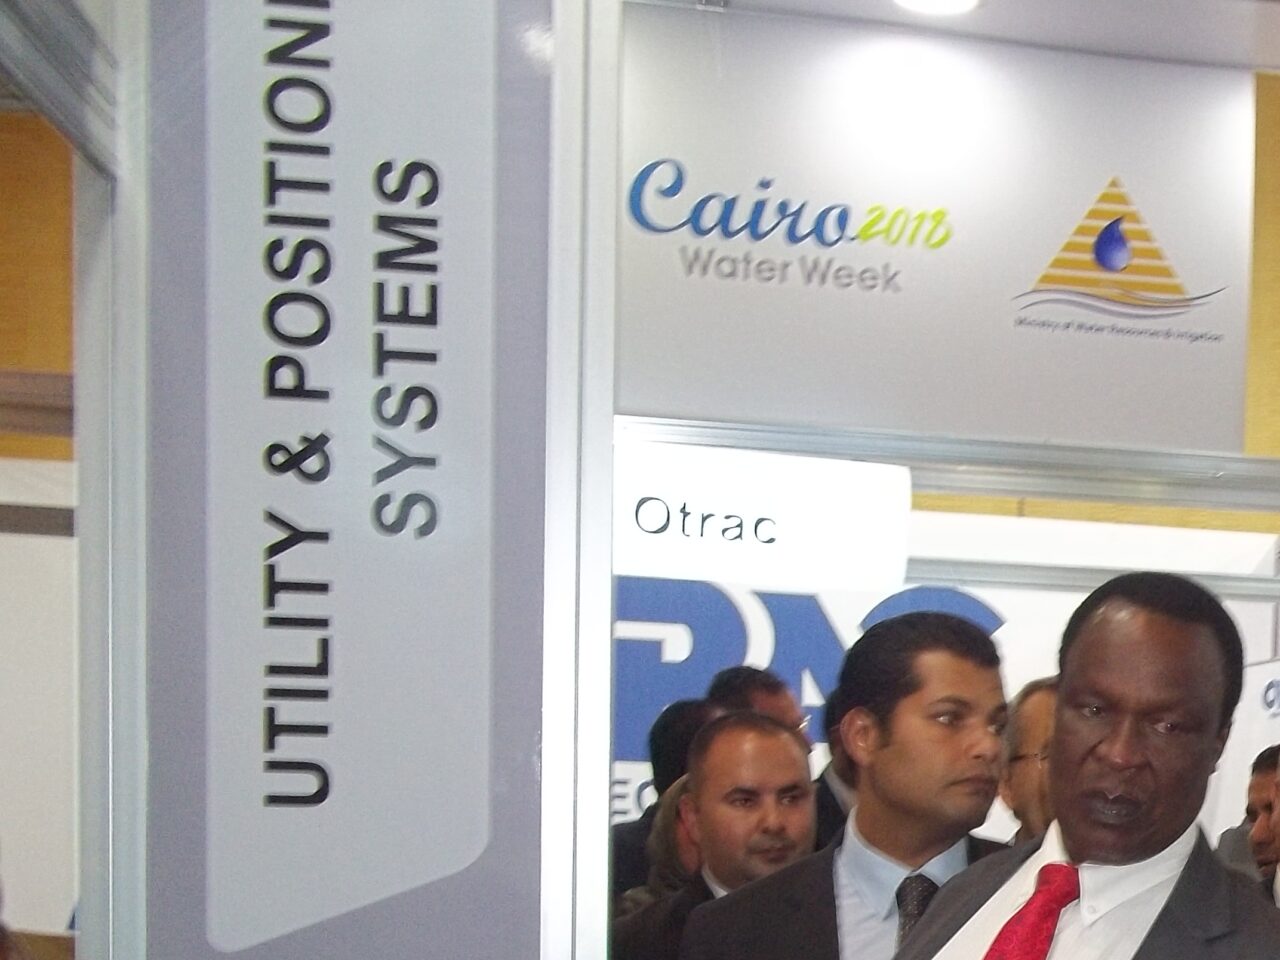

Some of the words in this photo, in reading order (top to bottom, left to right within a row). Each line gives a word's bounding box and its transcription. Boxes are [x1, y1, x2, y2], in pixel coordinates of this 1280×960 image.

[628, 158, 855, 248] Cairo
[856, 203, 953, 250] 2018
[678, 246, 793, 284] Water
[801, 255, 903, 294] Week
[373, 159, 440, 540] SYSTEMS
[263, 432, 331, 483] &
[634, 496, 778, 544] Otrac
[264, 509, 331, 808] UTILITY
